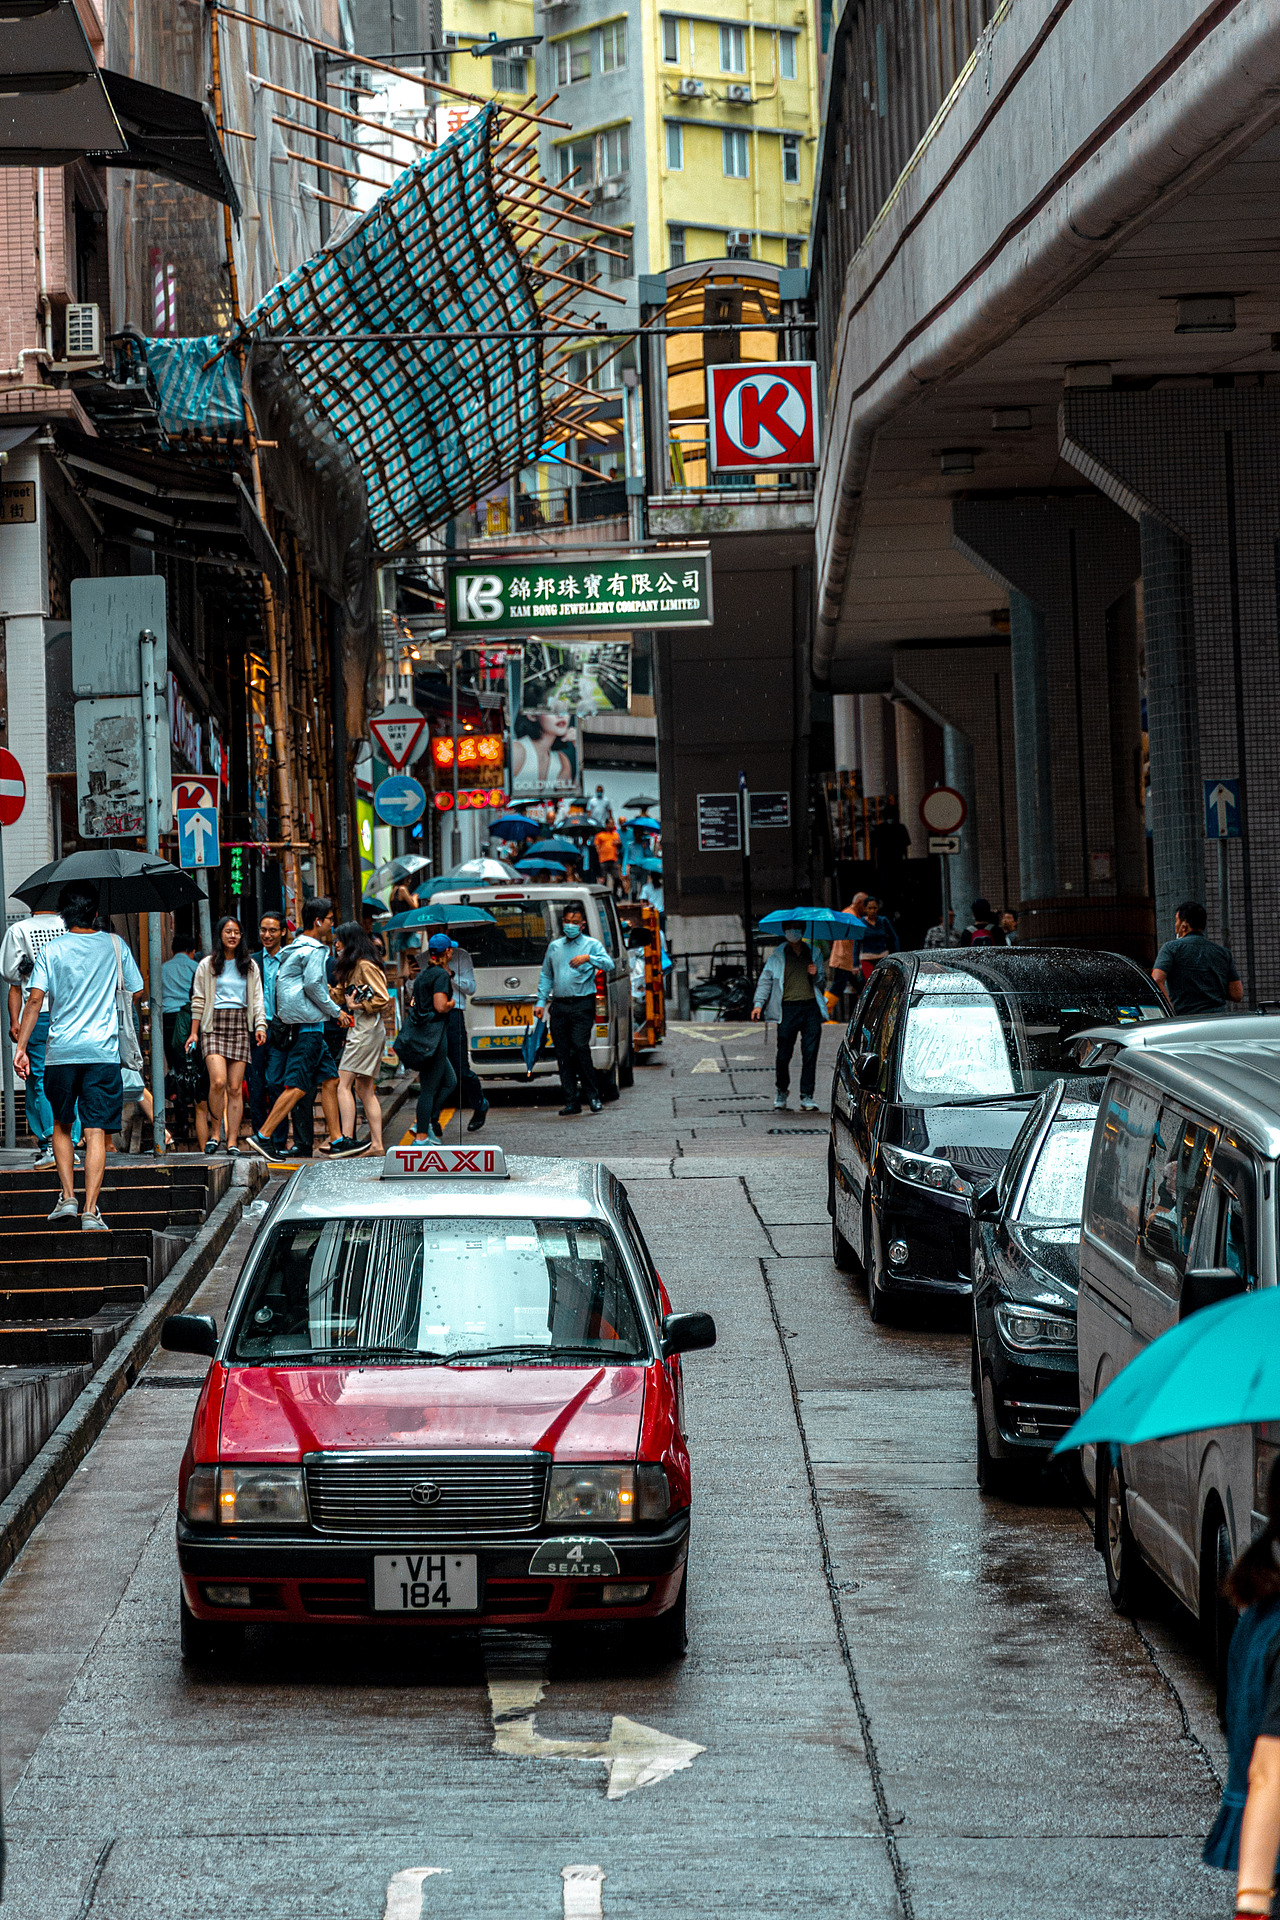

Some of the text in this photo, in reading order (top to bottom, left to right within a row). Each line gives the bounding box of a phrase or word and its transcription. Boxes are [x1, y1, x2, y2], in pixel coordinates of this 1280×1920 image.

[738, 383, 800, 450] K
[508, 570, 700, 601] 錦邦珠寶有限公司
[510, 598, 700, 617] KAM BONG JEWELLERY COMPANY LIMITED
[514, 779, 576, 790] GOLDWELL
[502, 1016, 527, 1026] 6191
[396, 1151, 494, 1172] TAXI
[566, 1545, 584, 1562] 4
[406, 1556, 446, 1582] VH
[548, 1563, 601, 1572] SEATS
[401, 1583, 451, 1608] 184
